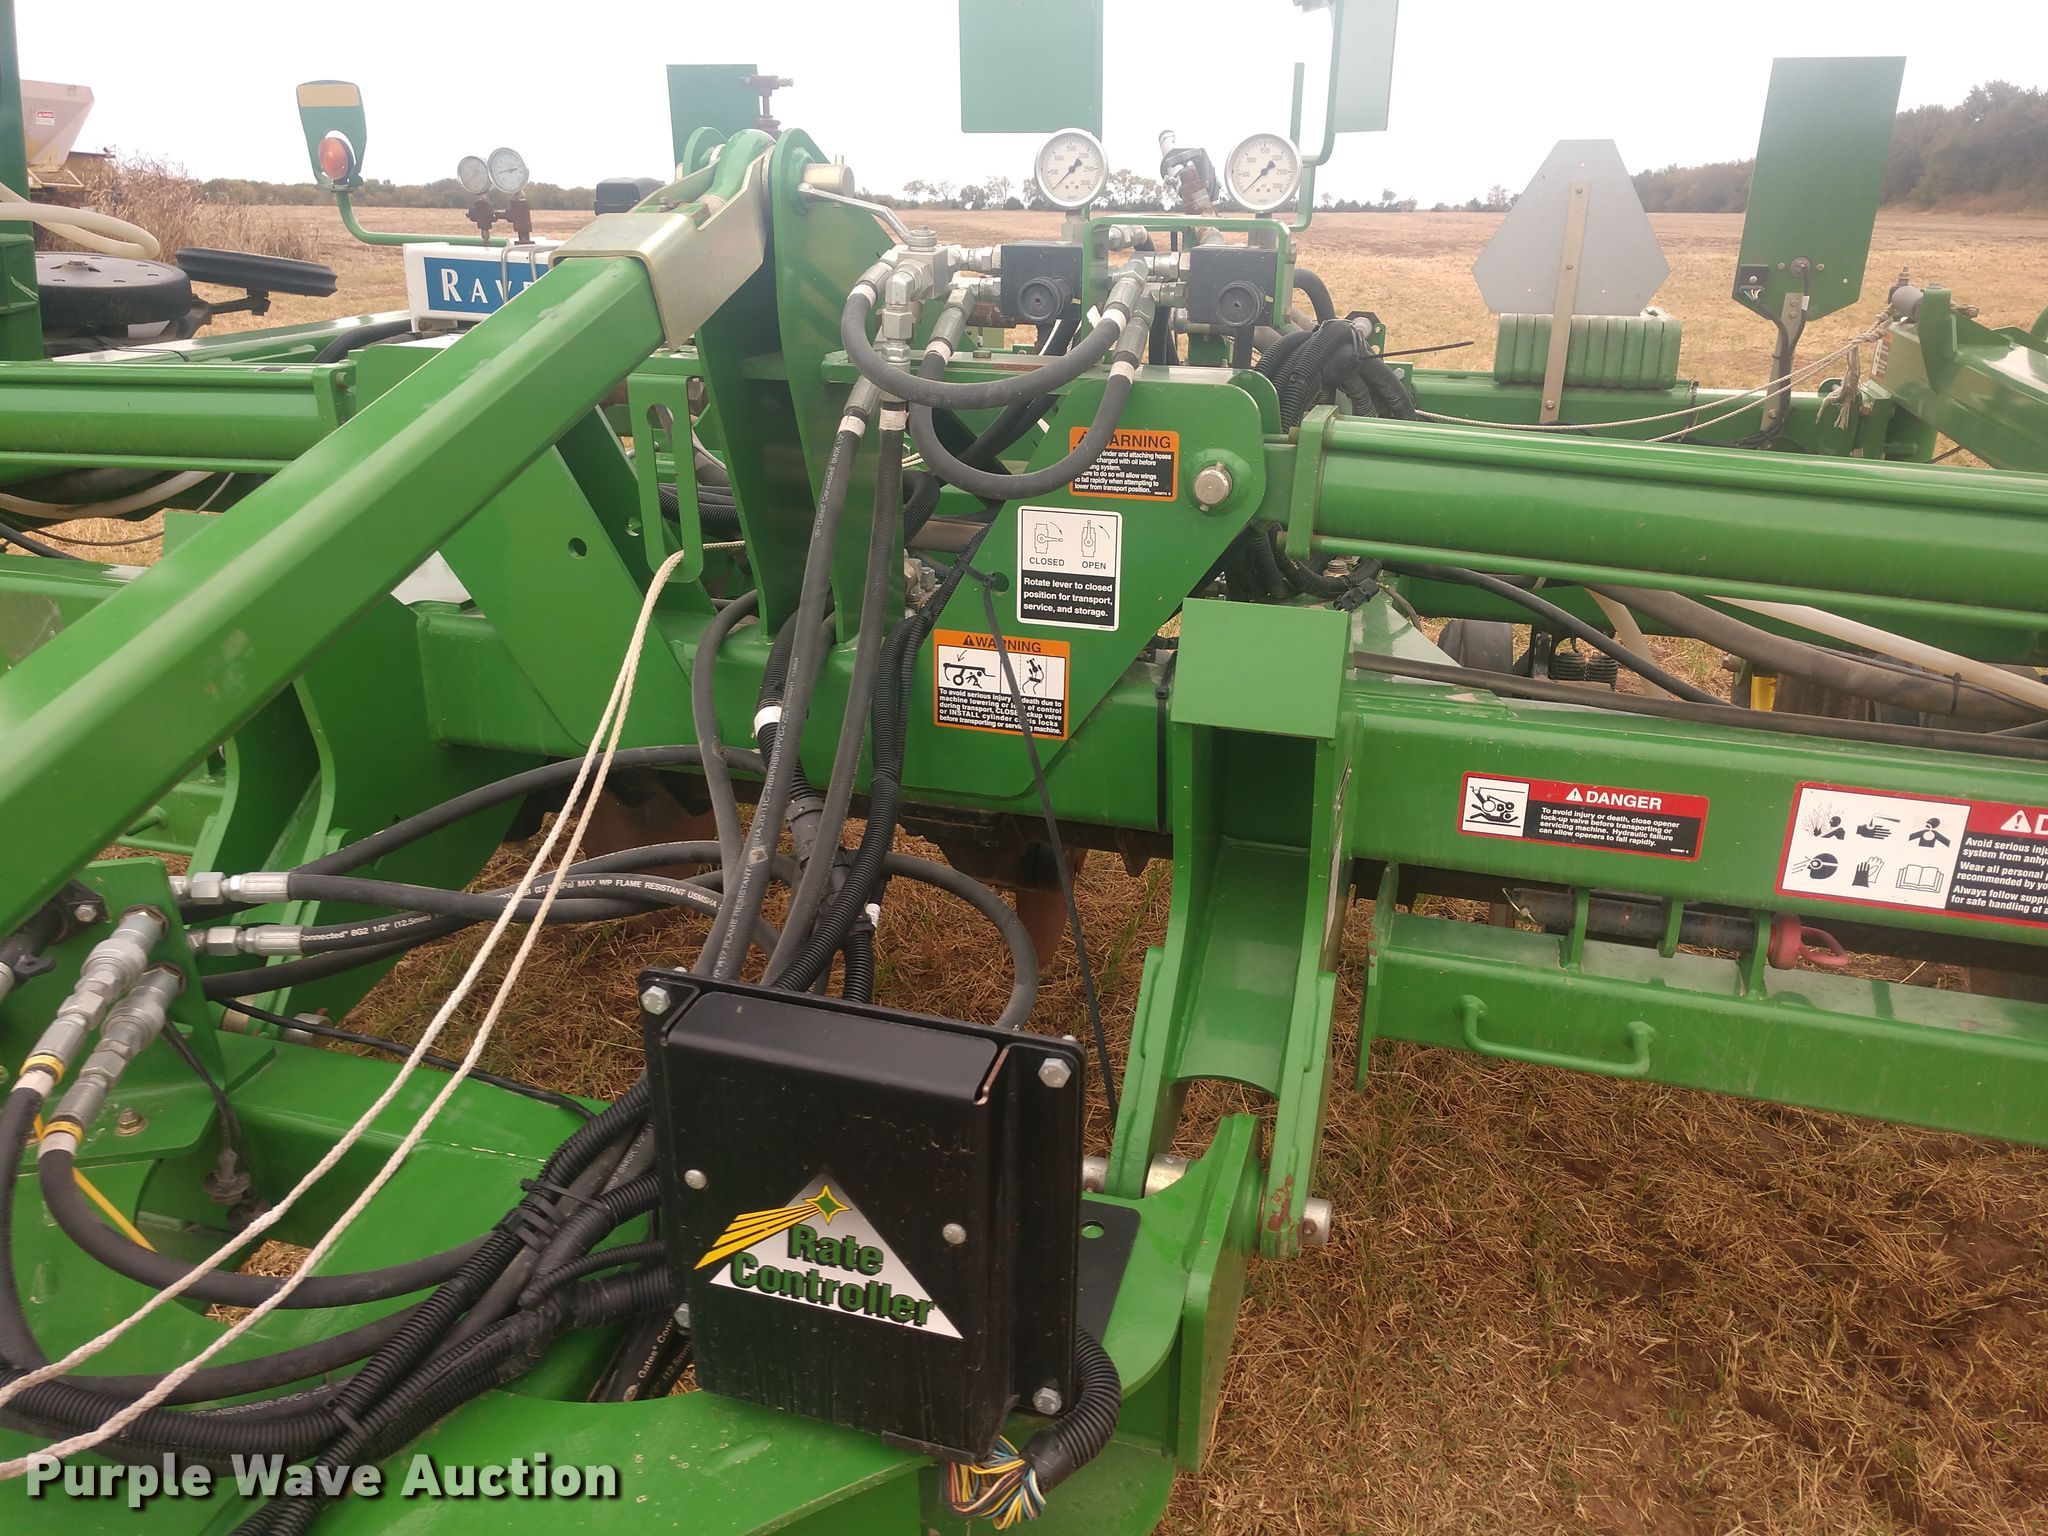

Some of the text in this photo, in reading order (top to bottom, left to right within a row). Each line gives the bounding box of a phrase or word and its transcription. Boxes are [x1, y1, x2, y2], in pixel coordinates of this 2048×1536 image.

[441, 268, 533, 303] RAV
[1109, 435, 1171, 448] ARNING
[1097, 457, 1118, 465] charged
[1129, 451, 1153, 460] attaching
[1124, 479, 1152, 487] attempting
[1030, 557, 1064, 566] CLOSED
[1082, 561, 1106, 569] OPEN
[1024, 577, 1112, 592] Rotate lever to closed
[1024, 591, 1113, 605] position for transport,
[1024, 603, 1108, 617] service, and storage.
[967, 690, 991, 698] serious
[993, 692, 1011, 702] injury
[1022, 697, 1040, 705] death
[1041, 698, 1053, 706] due
[969, 697, 999, 708] lowering
[1037, 706, 1061, 714] control
[940, 702, 961, 711] during
[996, 708, 1018, 716] CLOSE
[1026, 712, 1043, 720] ckup
[949, 709, 980, 718] INSTALL
[982, 713, 1012, 722] cylinder
[940, 714, 958, 722] before
[959, 717, 996, 728] transporting
[1034, 726, 1061, 734] machine.
[1586, 790, 1662, 810] DANGER
[1541, 814, 1568, 824] lock-up
[1591, 819, 1614, 828] before
[1616, 823, 1662, 834] transporting
[1574, 811, 1595, 820] injury
[1607, 814, 1629, 824] death,
[1632, 817, 1651, 825] close
[1653, 820, 1679, 829] opener
[1540, 821, 1673, 841] servicing machine. Hydraulic failure
[1575, 832, 1605, 841] openers
[1616, 835, 1627, 843] fall
[1629, 837, 1656, 847] rapidly.
[1966, 838, 1991, 848] Avoid
[1994, 841, 2030, 852] serious
[1963, 848, 1996, 859] system
[1999, 851, 2021, 861] from
[1960, 861, 1985, 871] Wear
[1987, 865, 1999, 873] all
[2001, 867, 2043, 879] personal
[578, 880, 596, 888] MAX
[599, 879, 612, 887] WP
[616, 879, 641, 888] FLAME
[644, 882, 687, 896] RESISTANT
[1957, 872, 2021, 886] recommended
[2024, 879, 2036, 890] by
[1953, 885, 1987, 897] Always
[1989, 890, 2018, 900] follow
[1951, 895, 1964, 904] for
[1966, 897, 1986, 906] safe
[1989, 899, 2030, 913] handling
[2032, 905, 2042, 914] of
[394, 914, 431, 929] (12.5mm)
[787, 1224, 884, 1276] Rate
[730, 1250, 935, 1327] Controller
